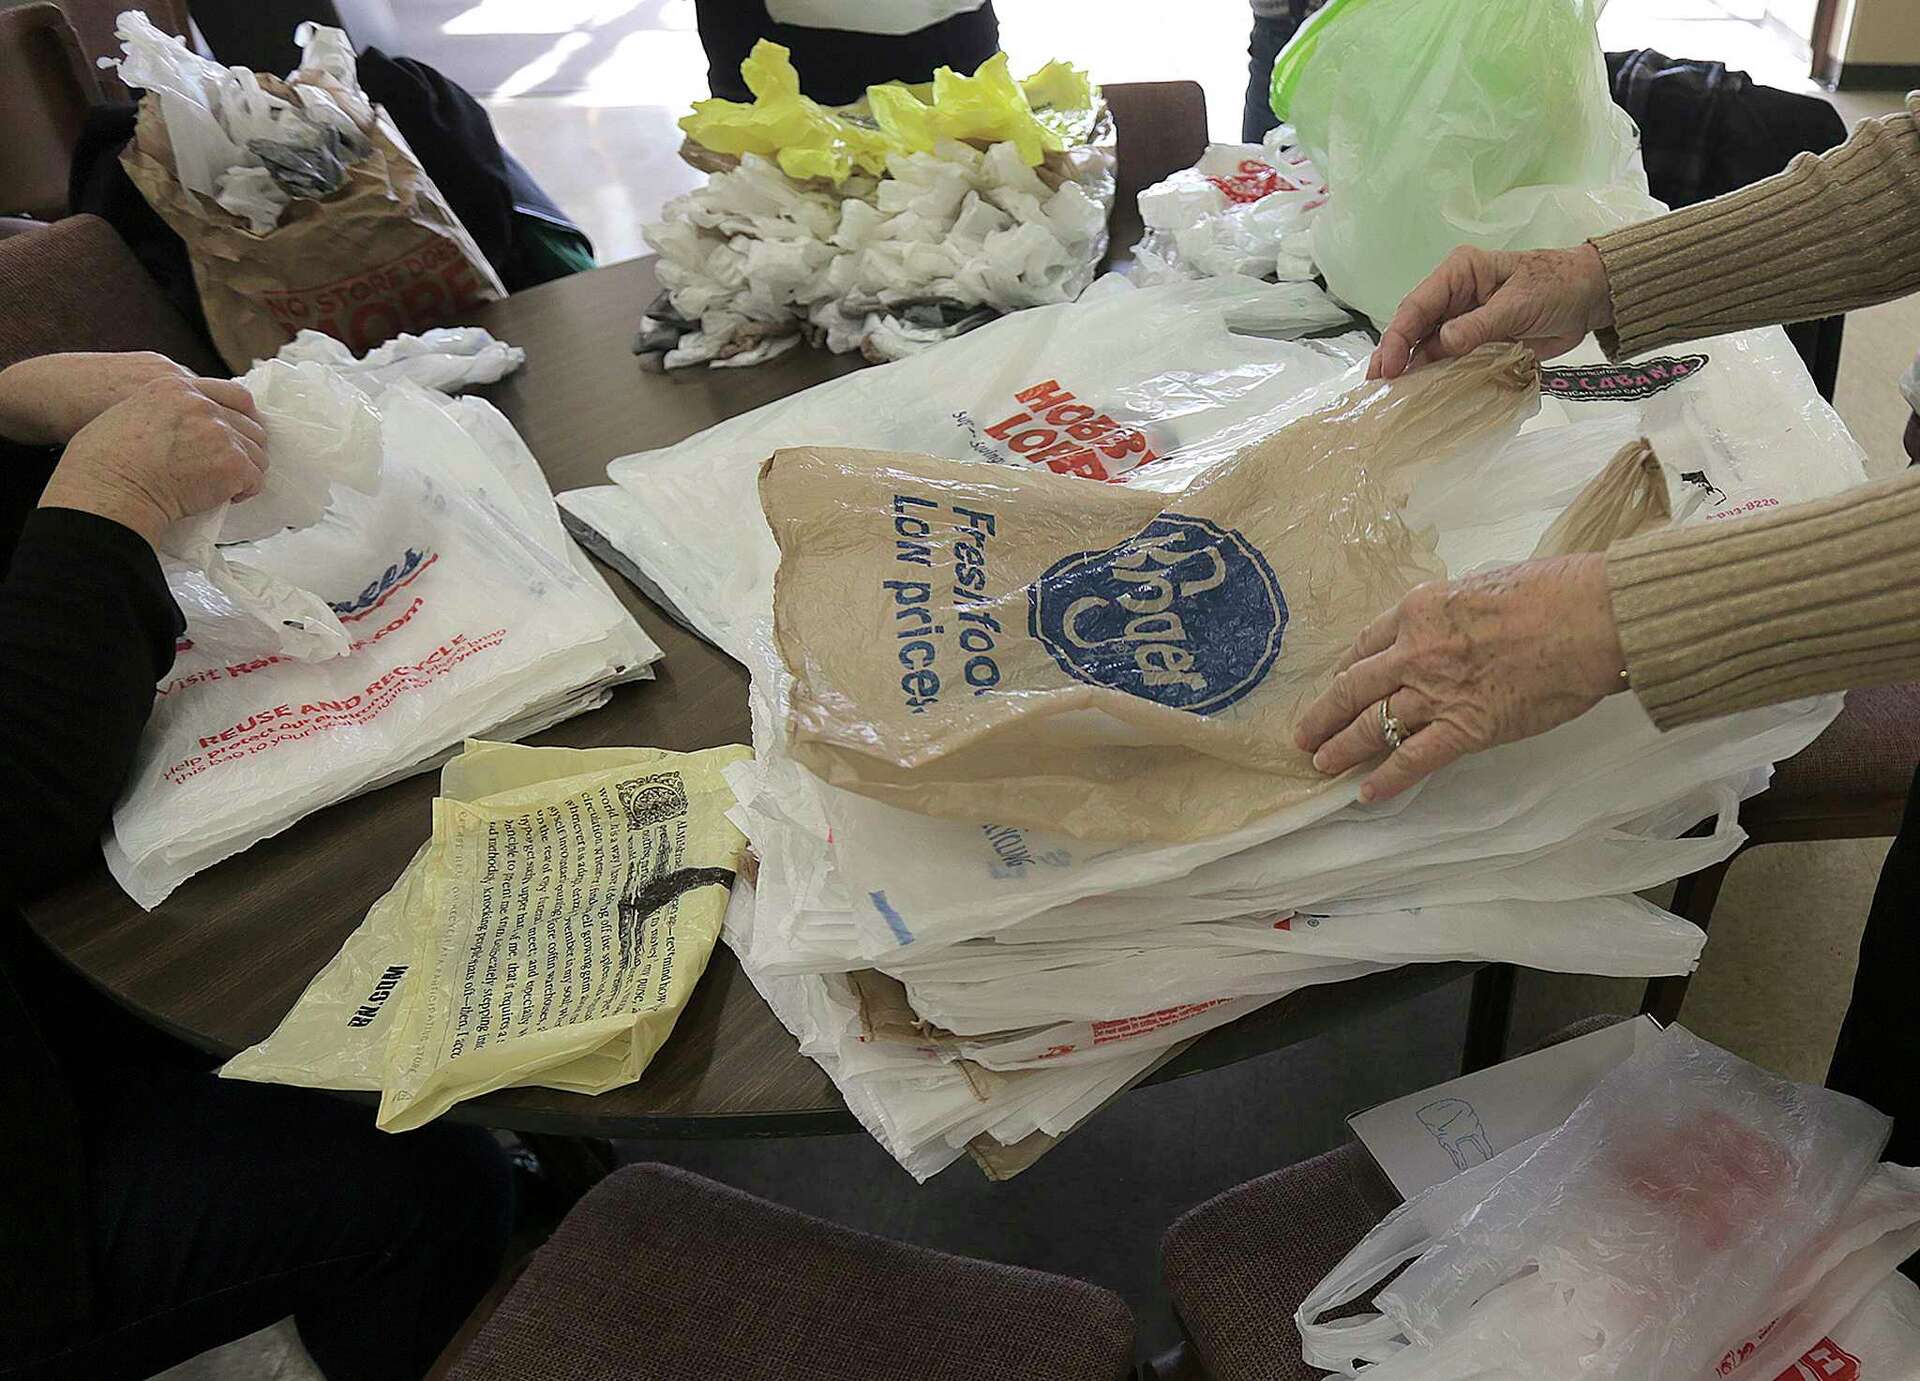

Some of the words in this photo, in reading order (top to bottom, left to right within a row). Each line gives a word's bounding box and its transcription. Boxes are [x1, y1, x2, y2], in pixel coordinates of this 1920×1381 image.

[1062, 531, 1227, 690] Kroger
[958, 611, 1001, 696] foo
[199, 703, 292, 749] REUSE
[301, 695, 361, 715] AND
[366, 633, 467, 697] RECYCLE
[163, 756, 202, 780] Help
[207, 727, 275, 760] protect
[174, 765, 207, 785] this
[209, 750, 244, 767] bag
[249, 741, 269, 754] to
[272, 730, 314, 747] your
[347, 964, 409, 1027] BN.COM
